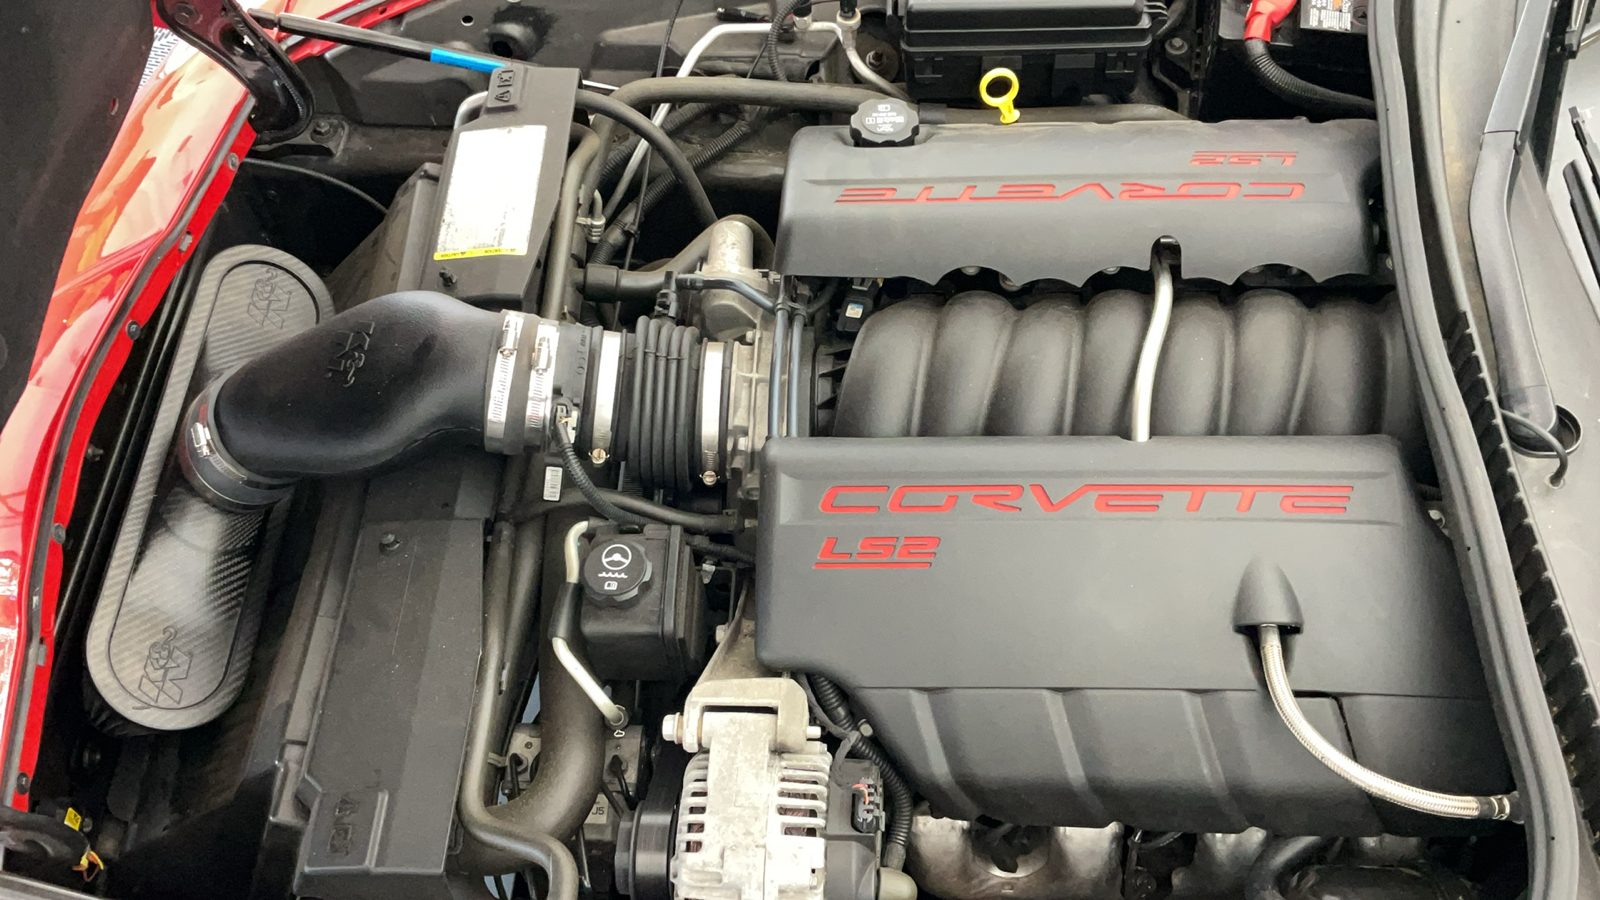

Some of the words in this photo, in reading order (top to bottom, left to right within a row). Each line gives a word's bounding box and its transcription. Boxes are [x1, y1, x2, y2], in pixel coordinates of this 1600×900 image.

[1190, 151, 1296, 166] LS2
[835, 182, 1305, 204] CORVETTE
[820, 484, 1352, 513] CORVETTE
[817, 536, 940, 560] LS2
